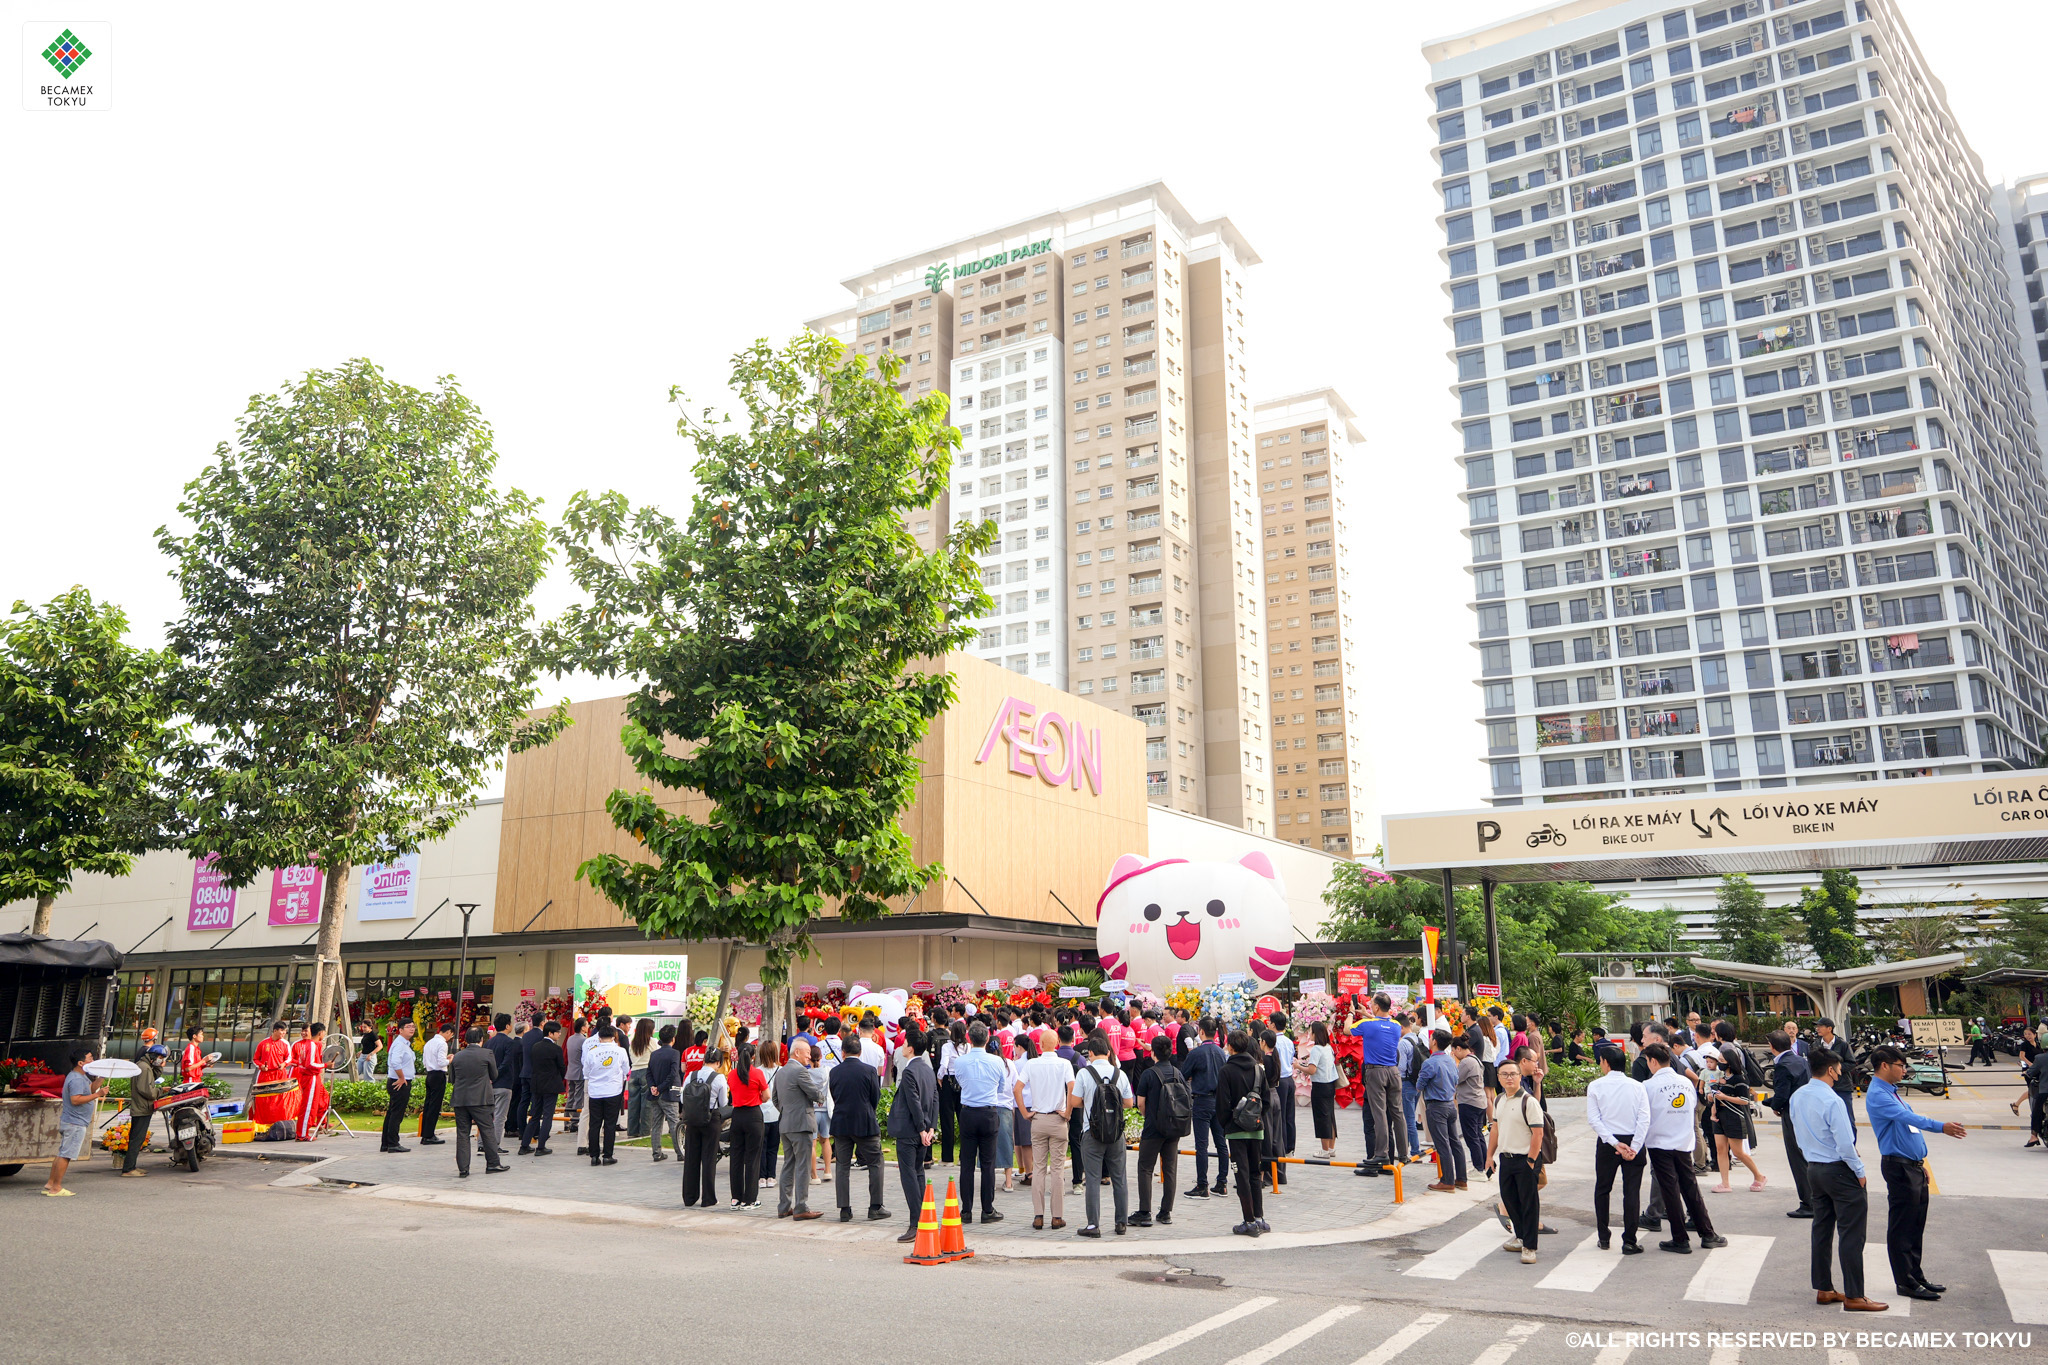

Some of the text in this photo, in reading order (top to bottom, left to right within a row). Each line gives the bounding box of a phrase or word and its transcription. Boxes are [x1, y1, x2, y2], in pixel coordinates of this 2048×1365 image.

[953, 238, 1052, 279] MIDORI PARK
[1973, 786, 2003, 805] LỐI
[2007, 790, 2034, 803] RA
[1743, 797, 1879, 820] LỐI VÀO XE MÁY
[2001, 810, 2031, 821] CAR
[1572, 810, 1682, 830] LỐI RA XE MÁY
[1792, 822, 1834, 834] BIKE IN
[1477, 820, 1501, 852] P
[1603, 833, 1655, 845] BIKE OUT
[299, 868, 313, 882] 20
[373, 871, 411, 887] Online
[196, 886, 232, 905] 08:00
[193, 906, 229, 926] 22:00
[657, 960, 681, 970] AEON
